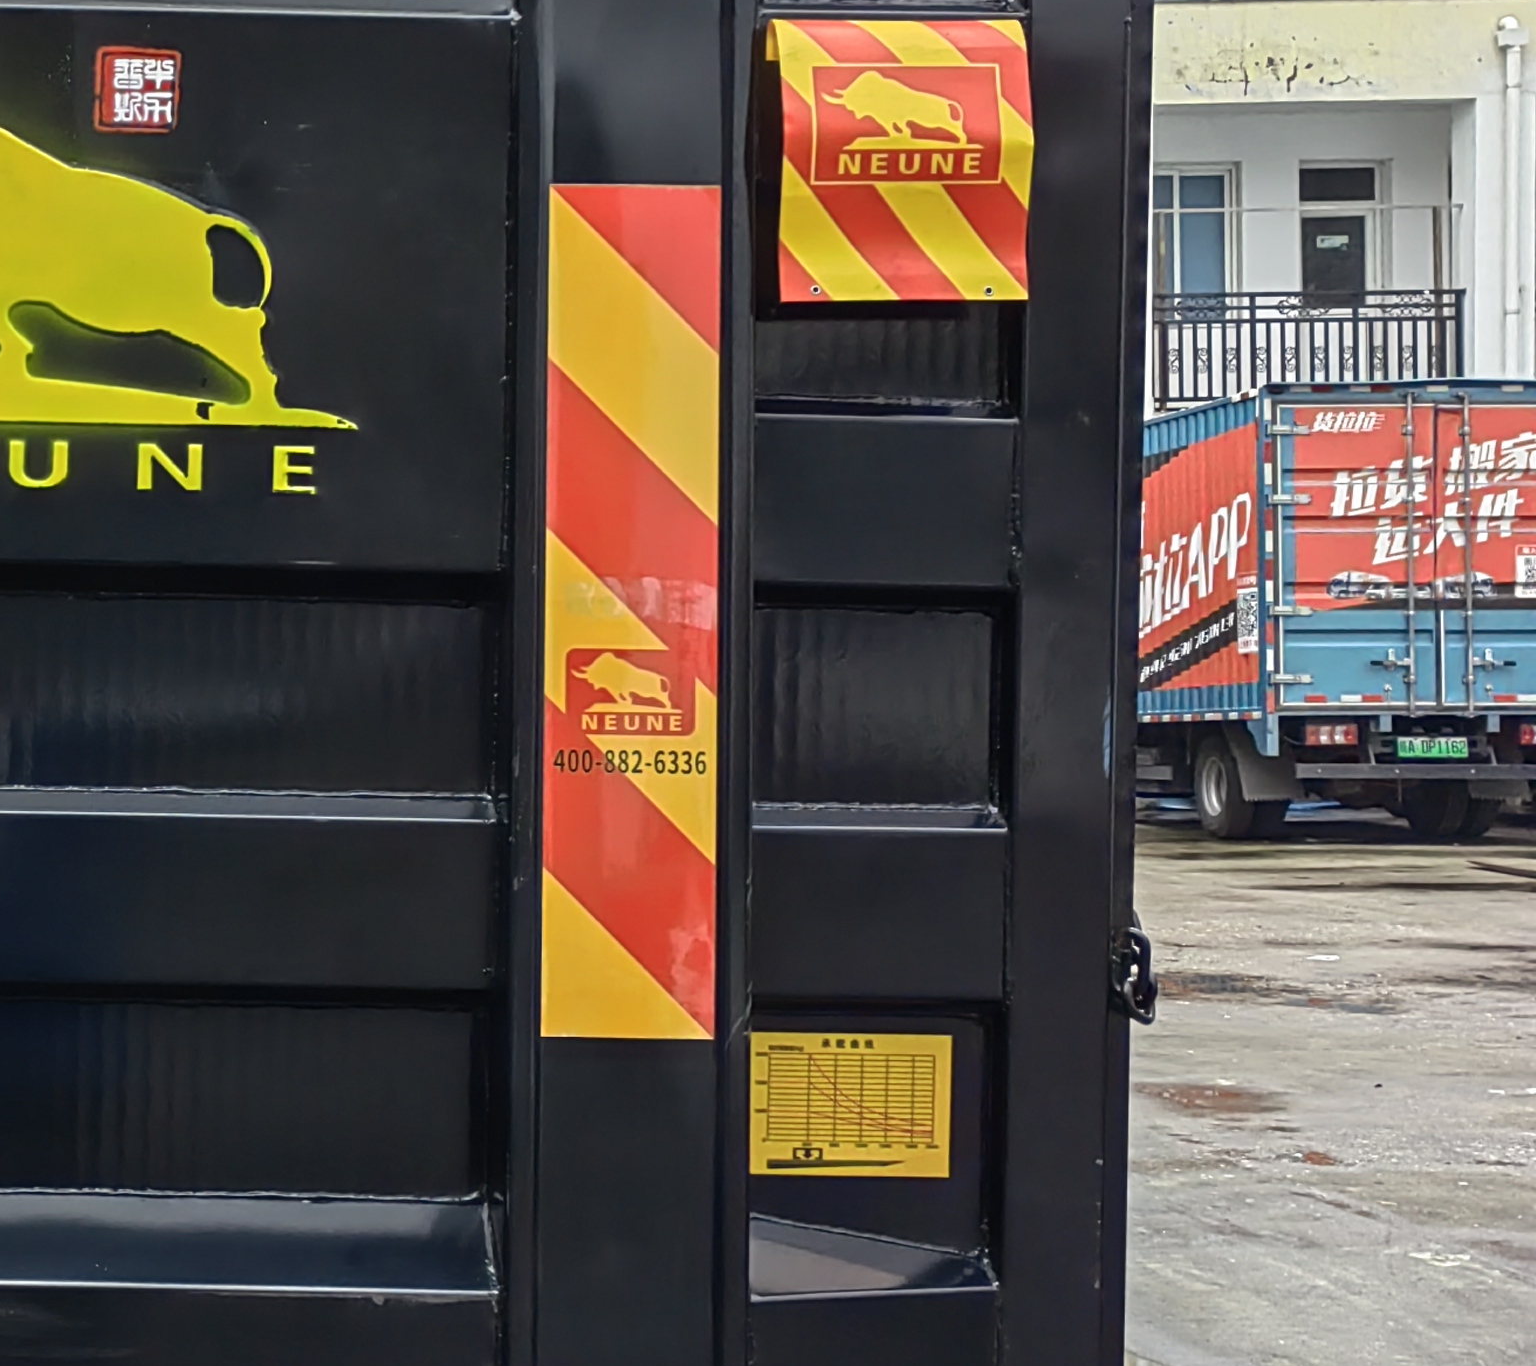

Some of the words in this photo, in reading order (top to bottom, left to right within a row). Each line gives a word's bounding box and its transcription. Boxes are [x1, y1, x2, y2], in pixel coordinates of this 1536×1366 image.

[837, 152, 982, 175] NEUNE
[581, 714, 683, 731] NEUNE
[553, 749, 707, 774] 400-882-6336
